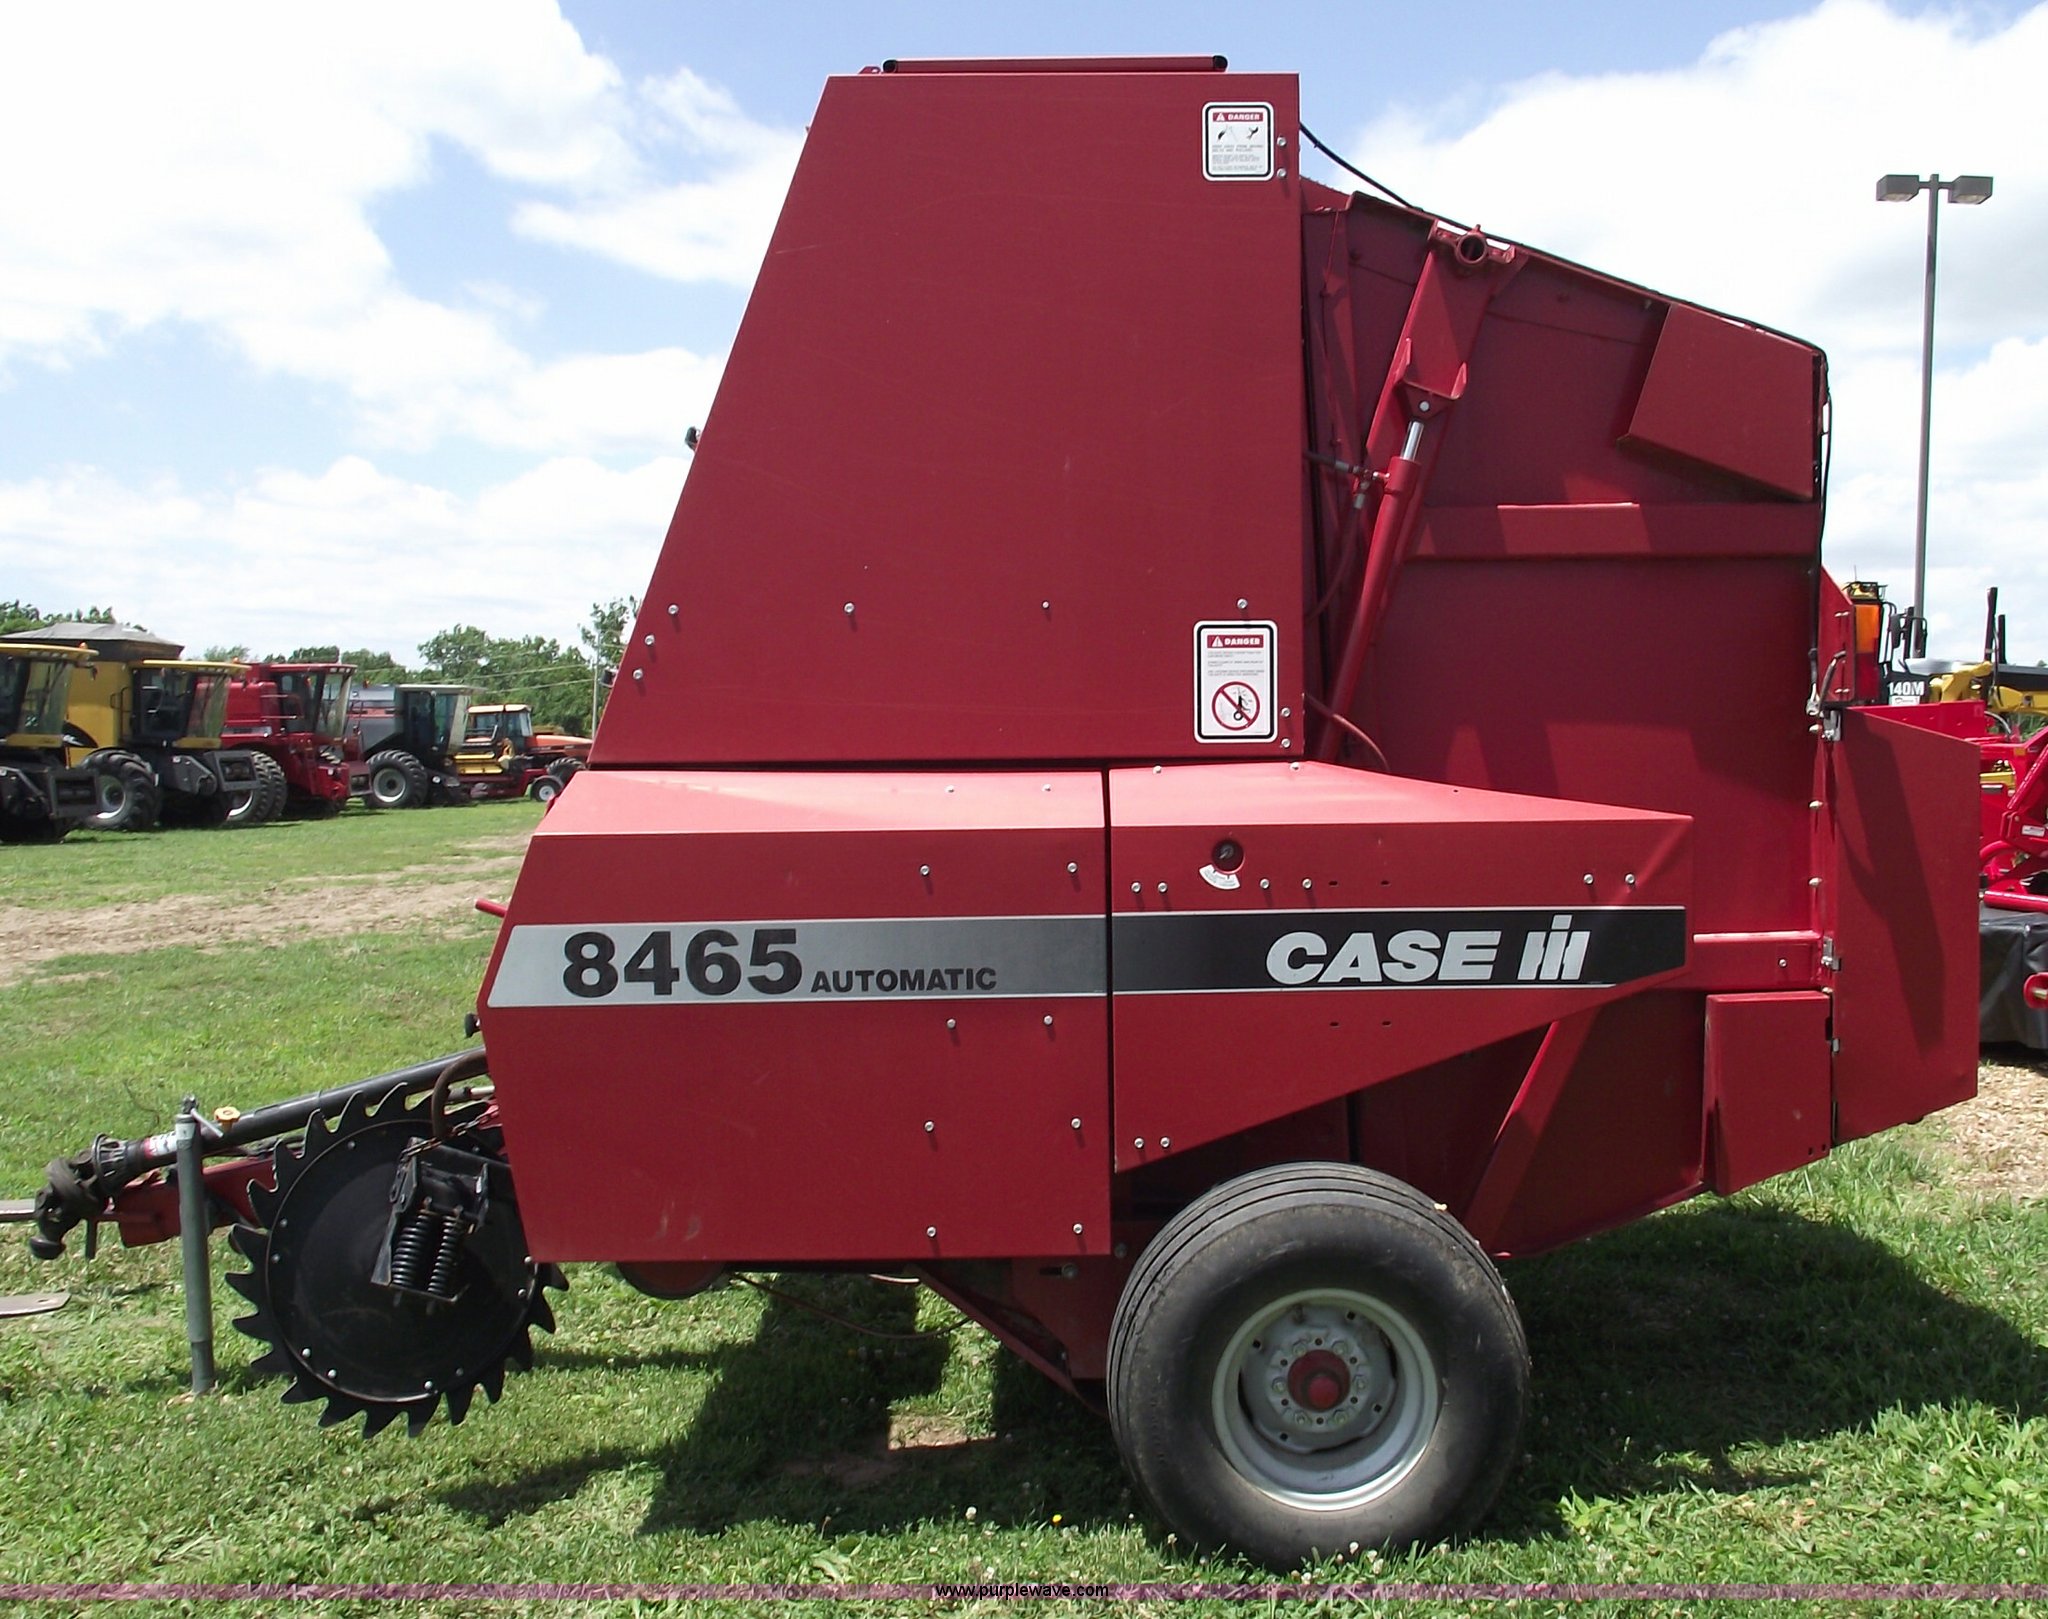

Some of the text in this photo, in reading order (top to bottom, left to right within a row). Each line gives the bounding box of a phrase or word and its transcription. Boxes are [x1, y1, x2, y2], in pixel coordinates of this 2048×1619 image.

[1227, 113, 1260, 121] DANGER
[1224, 637, 1261, 646] DANGER
[1887, 680, 1925, 696] 140M
[562, 928, 998, 998] 8465 AUTOMATIC
[1265, 930, 1502, 985] CASE
